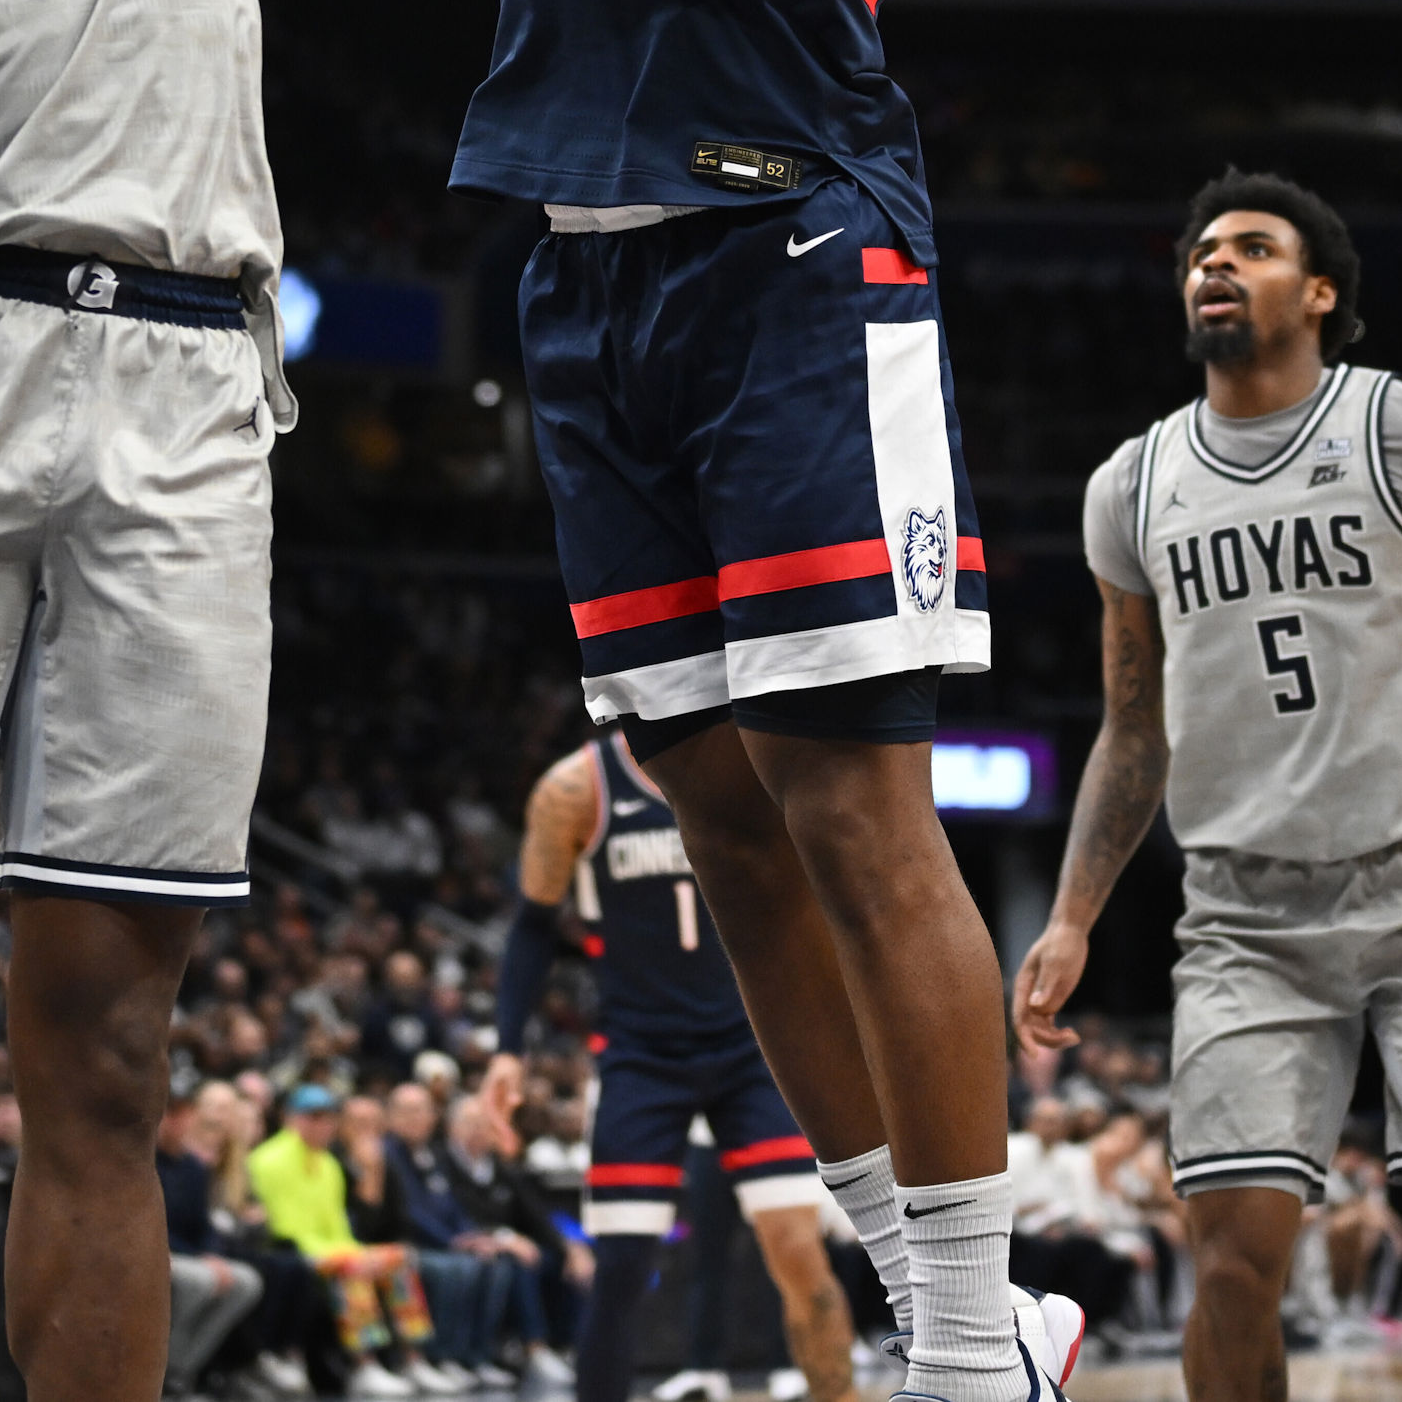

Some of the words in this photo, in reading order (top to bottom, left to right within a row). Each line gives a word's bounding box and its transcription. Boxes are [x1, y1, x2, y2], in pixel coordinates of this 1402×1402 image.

[766, 162, 785, 178] 52
[1166, 514, 1373, 616] HOYAS
[1255, 613, 1317, 716] 5
[673, 879, 699, 952] 1
